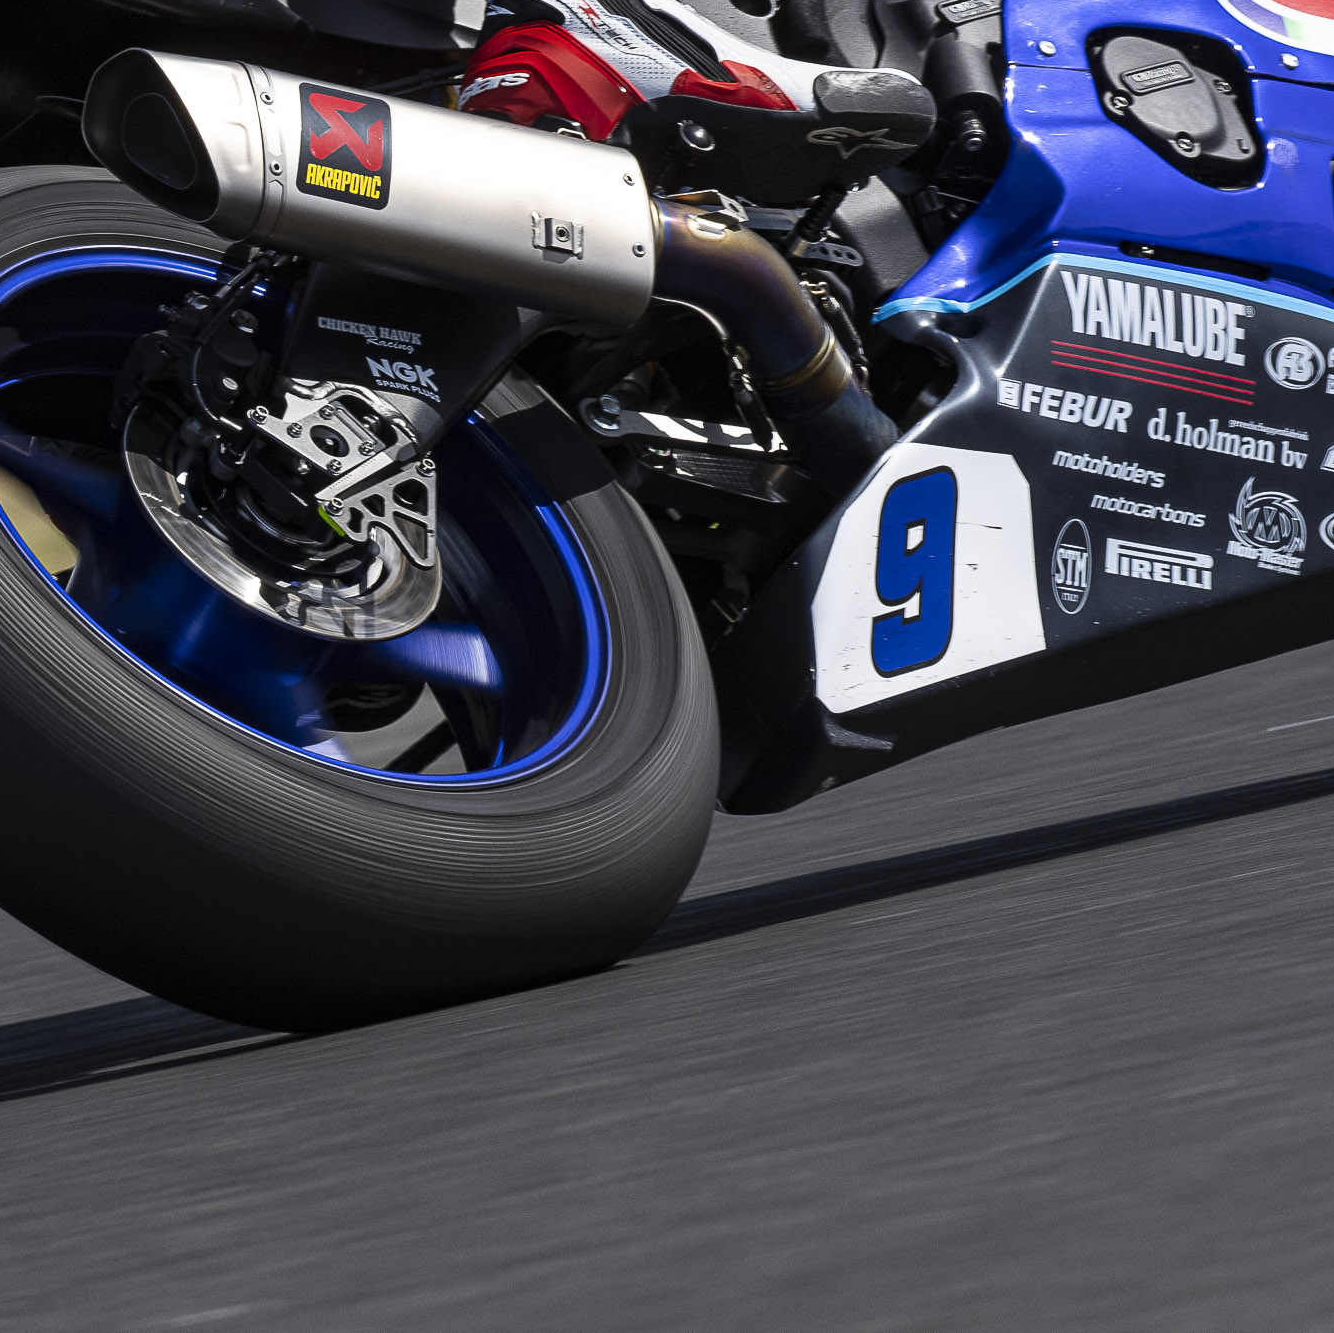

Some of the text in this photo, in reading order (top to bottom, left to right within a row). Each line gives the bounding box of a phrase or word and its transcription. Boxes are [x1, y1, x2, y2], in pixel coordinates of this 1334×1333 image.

[306, 163, 382, 199] AKRAPOVIČ
[317, 316, 422, 345] CHICKEN HAWK
[1060, 270, 1247, 366] YAMALUBE
[365, 336, 415, 354] Racing
[366, 356, 439, 392] NGK
[375, 379, 442, 403] SPARK PLUGS
[1021, 382, 1133, 433] FEBUR
[1147, 407, 1308, 469] d. holman bv
[1052, 450, 1166, 488] motoholders
[1090, 494, 1207, 528] motocarbons
[871, 465, 958, 678] 9
[1055, 548, 1088, 588] STM
[1104, 537, 1214, 590] PIRELLI
